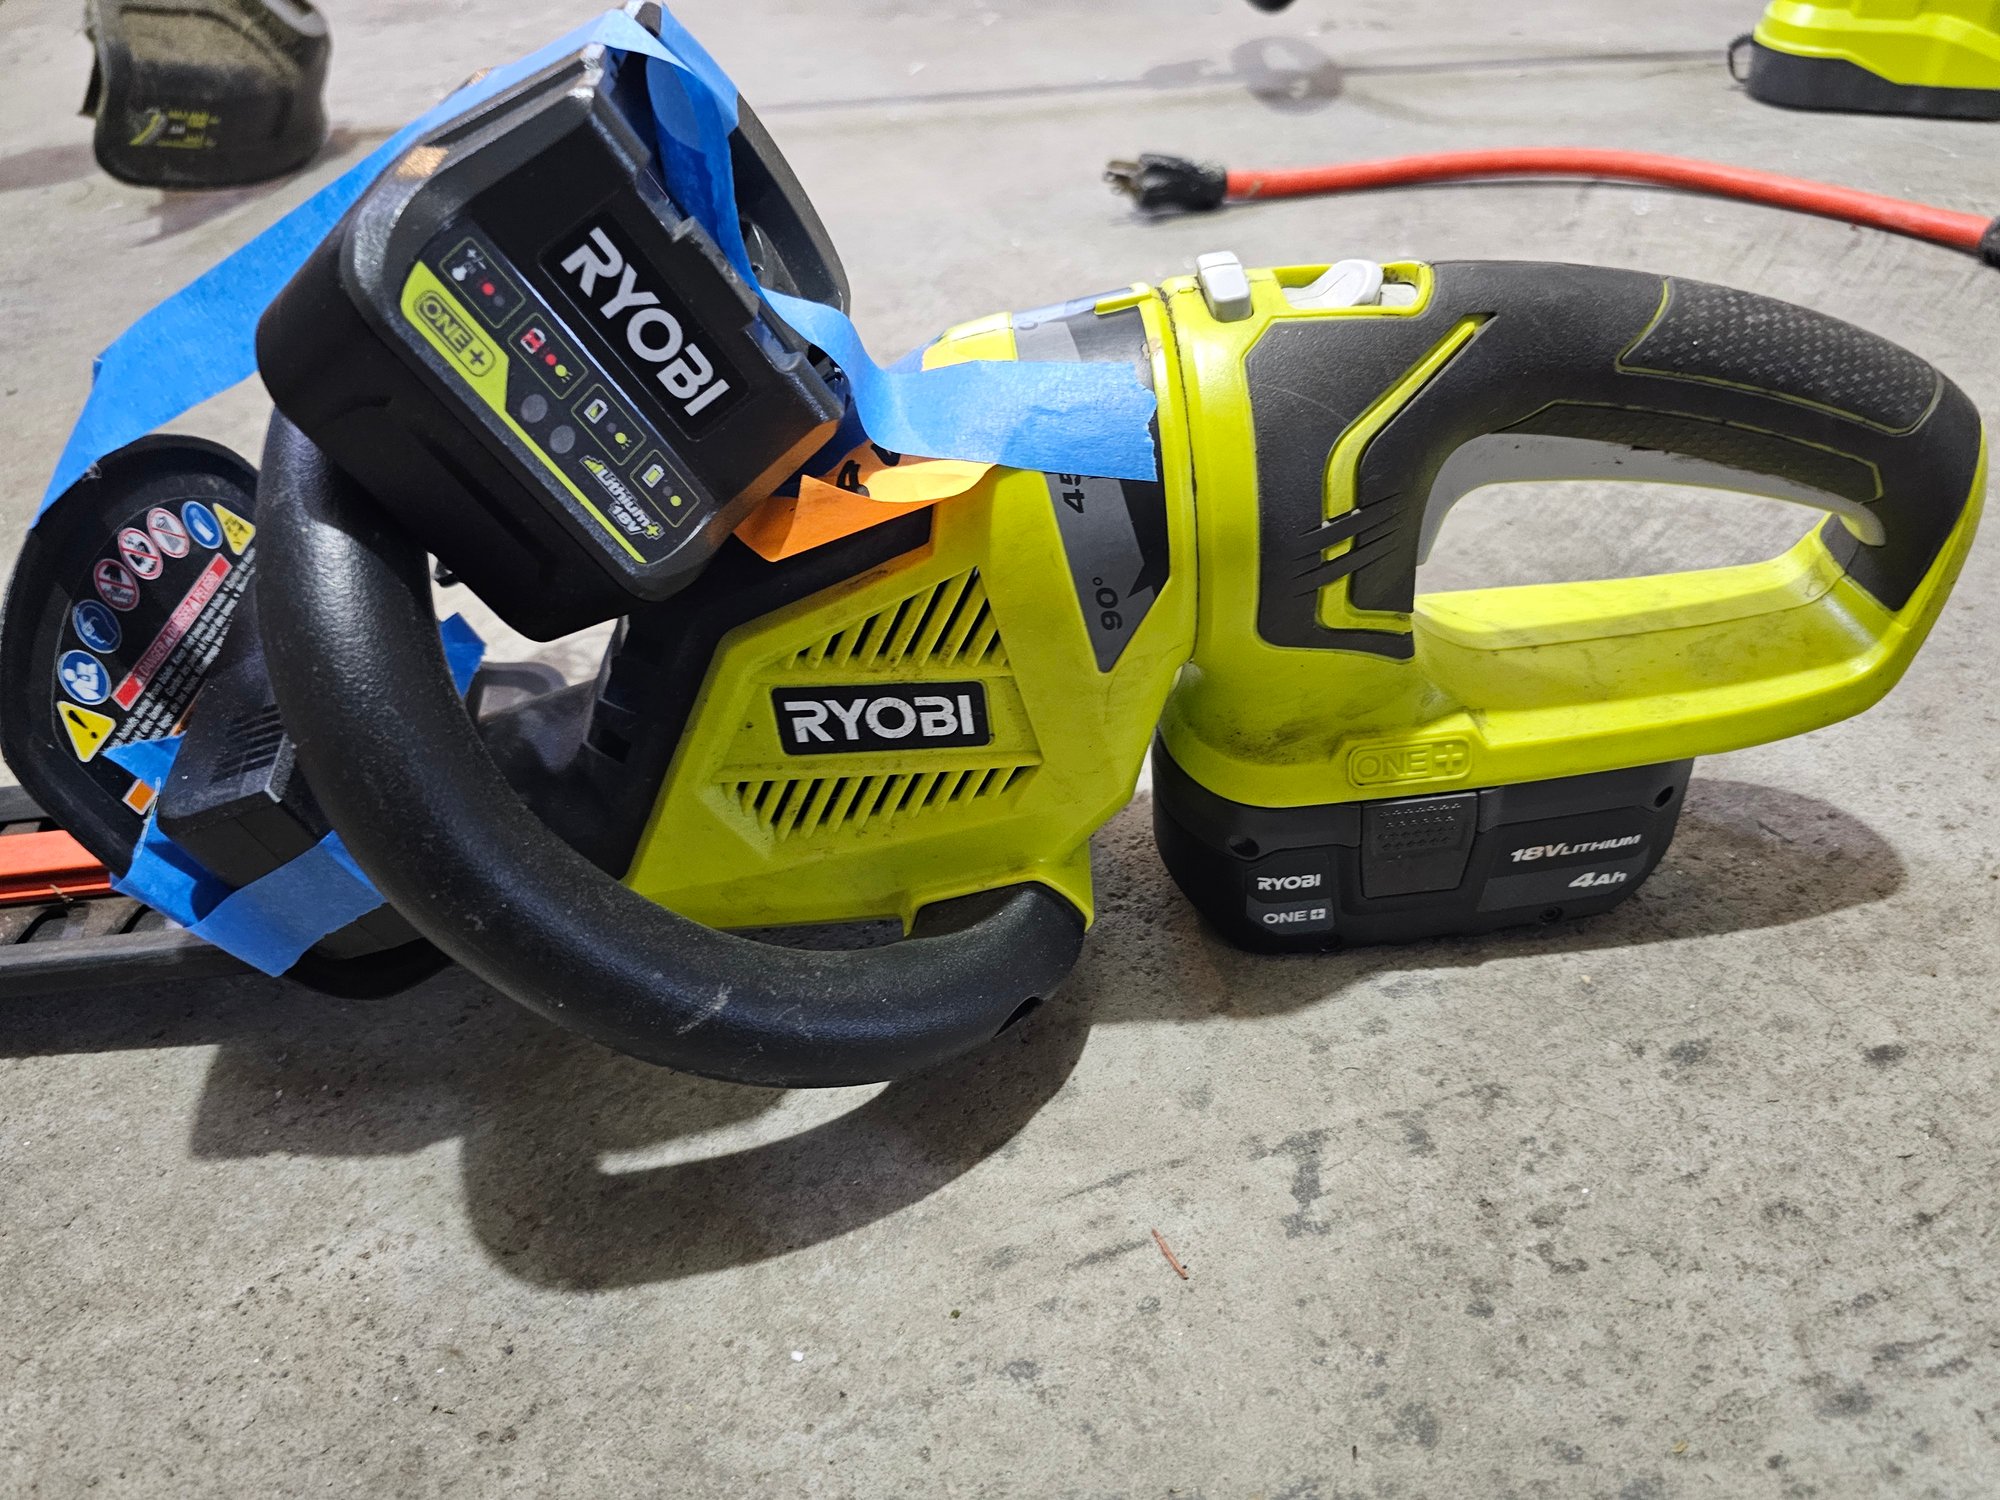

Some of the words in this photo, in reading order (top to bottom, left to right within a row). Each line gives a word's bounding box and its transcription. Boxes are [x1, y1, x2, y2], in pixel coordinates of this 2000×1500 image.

[560, 226, 730, 417] RYOBI
[612, 504, 642, 532] 18V
[784, 695, 976, 743] RYOBI
[1256, 873, 1321, 891] RYOBI
[1568, 871, 1628, 888] 4Ah
